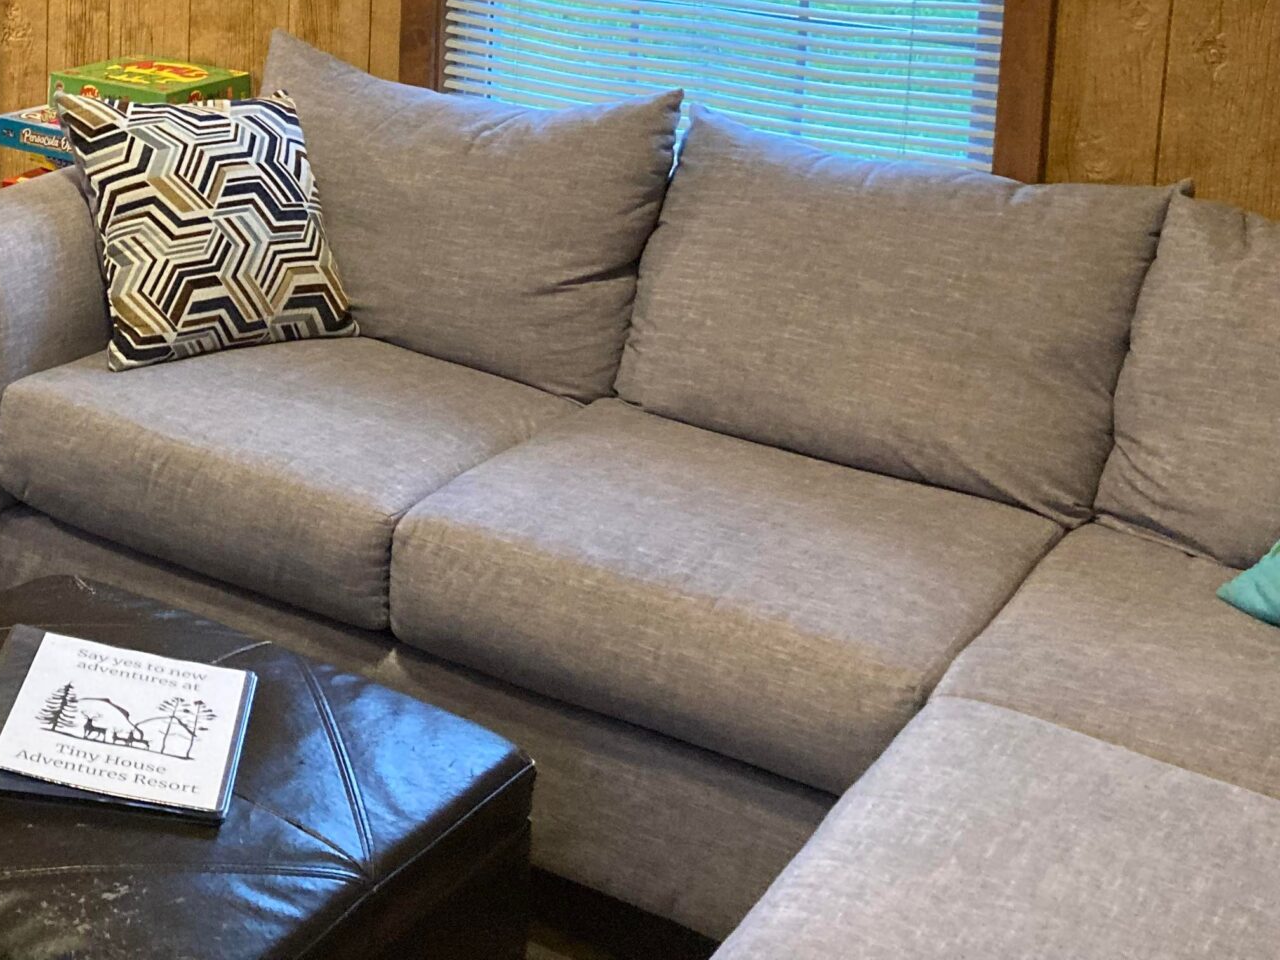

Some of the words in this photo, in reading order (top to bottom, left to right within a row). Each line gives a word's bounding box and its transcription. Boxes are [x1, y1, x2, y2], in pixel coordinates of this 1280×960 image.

[76, 660, 178, 688] adventures
[182, 682, 200, 692] at
[77, 648, 109, 662] Say
[113, 657, 142, 669] yes
[147, 662, 165, 673] to
[169, 670, 208, 681] new
[15, 748, 128, 782] Adventures
[132, 772, 200, 794] Resort
[55, 742, 100, 763] Tiny
[103, 753, 168, 774] House
